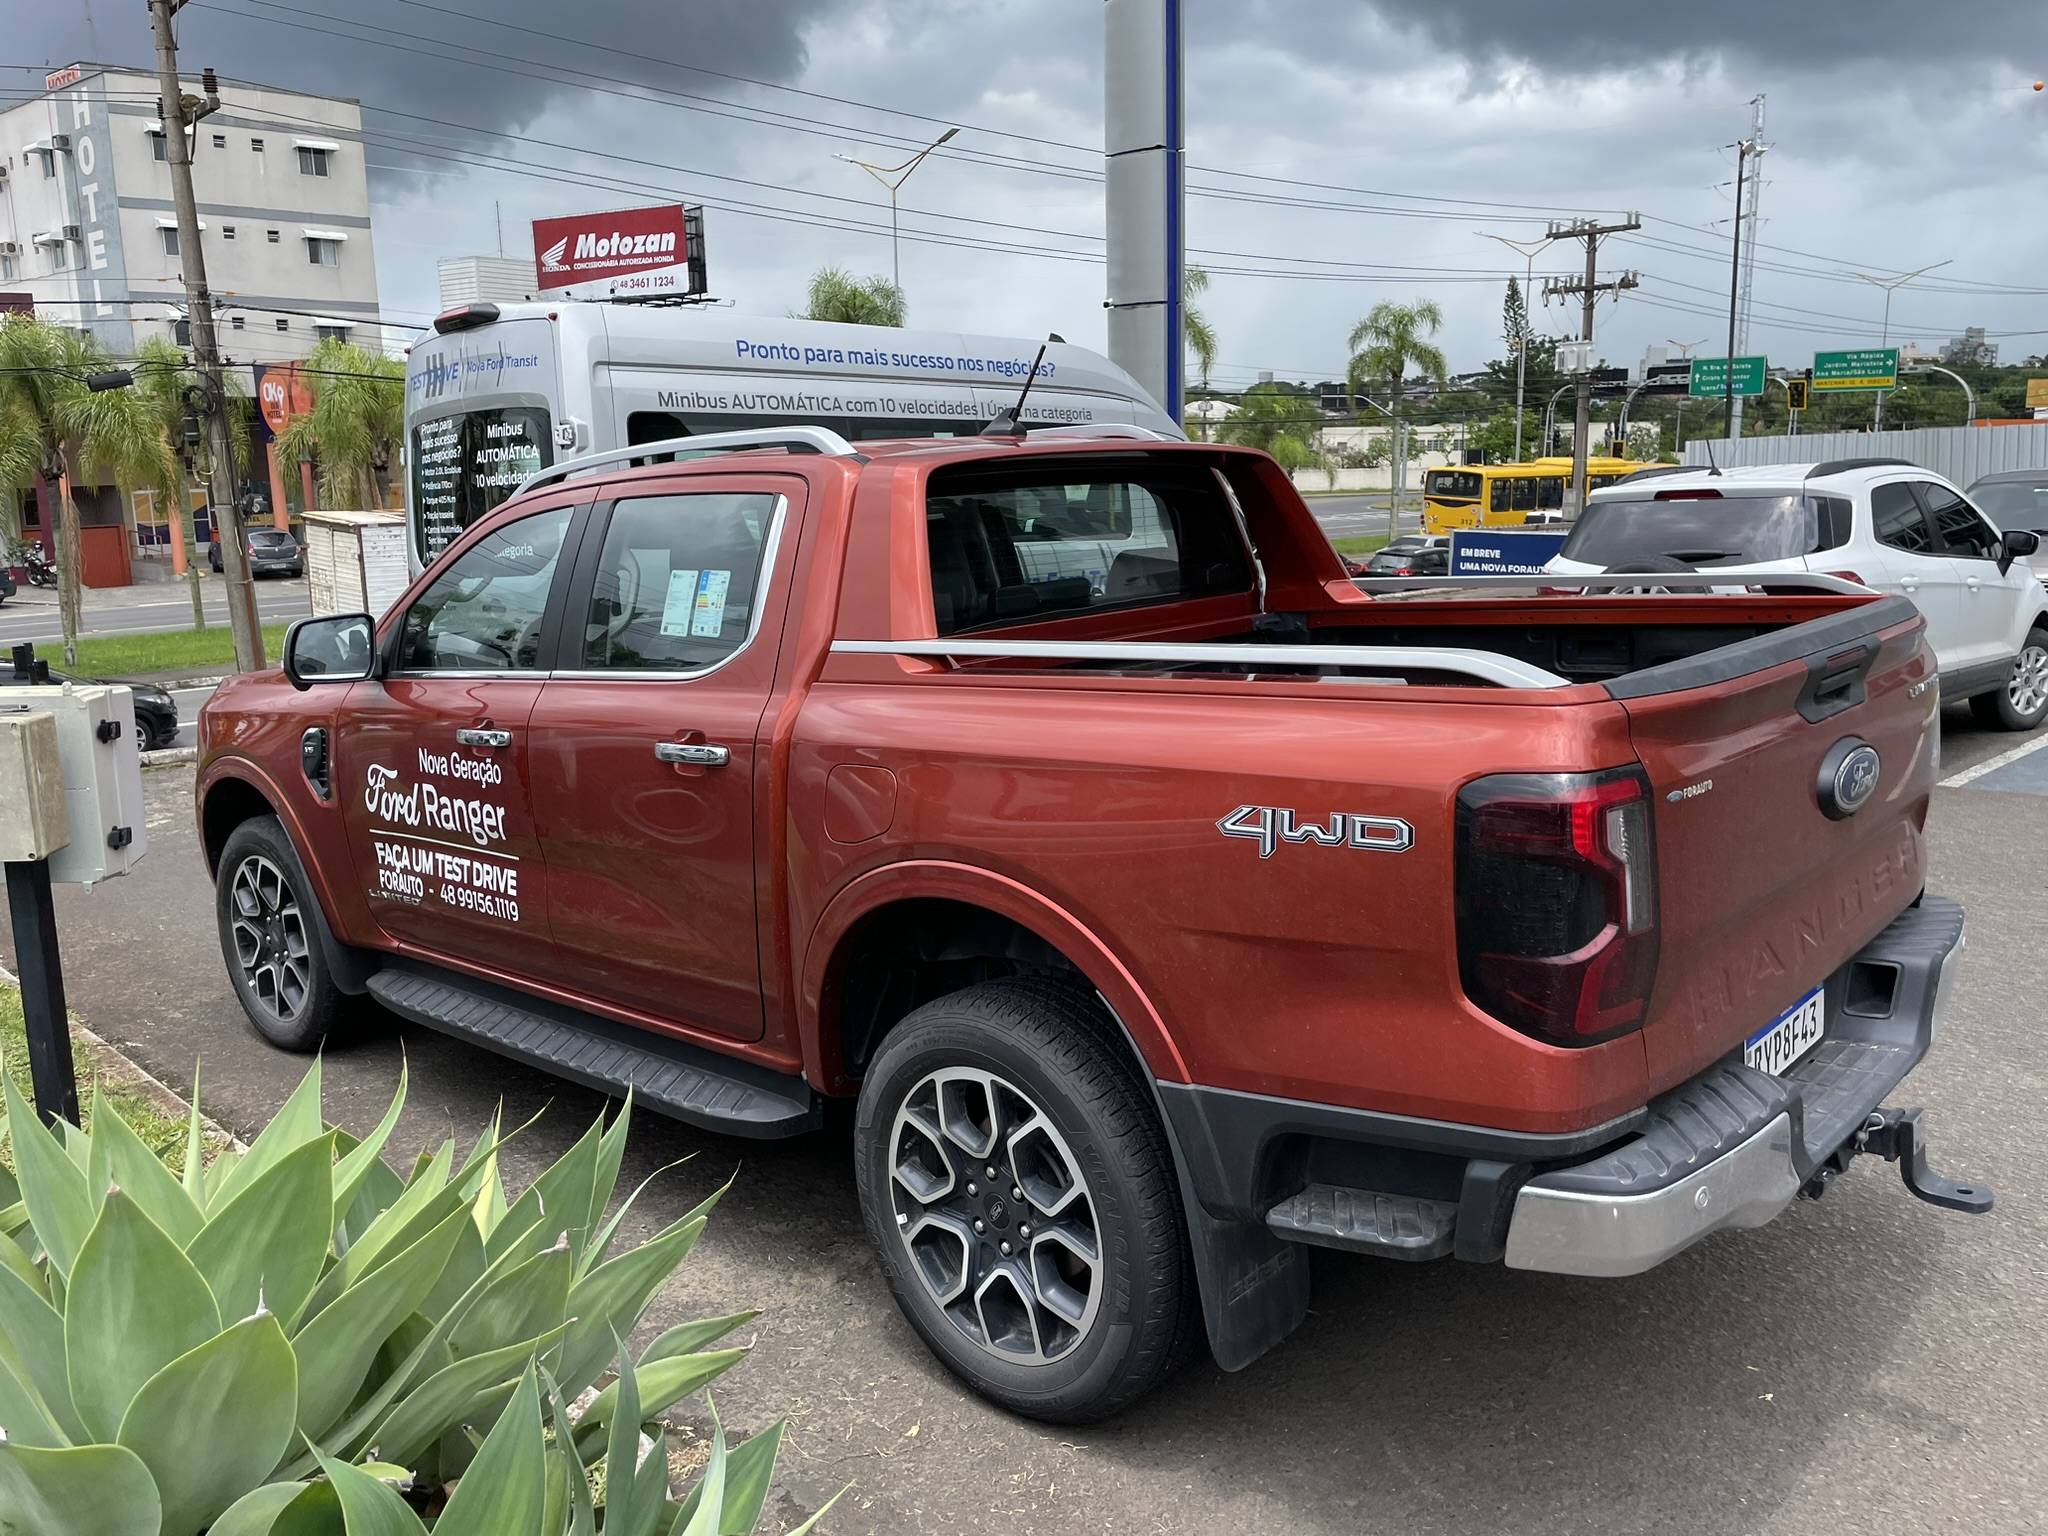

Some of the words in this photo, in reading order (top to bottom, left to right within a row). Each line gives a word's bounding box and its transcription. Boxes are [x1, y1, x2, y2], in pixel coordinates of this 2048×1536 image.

[71, 86, 113, 316] HOTEL
[574, 231, 676, 259] Motozan
[542, 264, 571, 273] HONDA
[573, 259, 618, 270] CONCESSIONÁRIA
[618, 257, 653, 267] AUTORIZADA
[653, 254, 675, 263] HONDA
[619, 280, 628, 289] 48
[629, 277, 650, 289] 3461
[654, 276, 675, 287] 1234
[466, 360, 486, 374] Nova
[486, 358, 504, 370] Ford
[506, 354, 538, 368] Transit
[736, 339, 800, 361] Pronto
[804, 346, 844, 365] para
[848, 348, 888, 367] mais
[891, 351, 953, 370] sucesso
[957, 356, 984, 372] nos
[658, 391, 728, 409] Minibus
[732, 391, 843, 413] AUTOMÁTICA
[846, 400, 877, 413] com
[880, 398, 896, 413] 10
[899, 398, 978, 416] velocidades
[1024, 408, 1040, 419] na
[1041, 407, 1093, 423] categoria
[421, 421, 439, 435] Pronto
[439, 419, 452, 433] para
[487, 422, 523, 438] Minibus
[421, 437, 434, 450] mais
[434, 433, 458, 447] sucesso
[422, 453, 431, 465] nos
[431, 445, 461, 464] negócios?
[476, 443, 540, 464] AUTOMÁTICA
[475, 474, 485, 488] 10
[1460, 518, 1473, 526] 312
[1461, 547, 1474, 558] EM
[1474, 549, 1501, 559] BREVE
[1460, 562, 1480, 571] UMA
[1481, 563, 1507, 572] NOVA
[1507, 564, 1544, 574] FORAUT
[418, 747, 448, 776] Nova
[450, 751, 502, 788] Geração
[1851, 761, 1875, 797] Ford
[1682, 779, 1713, 800] FORAUTO
[365, 763, 422, 826] Ford
[422, 783, 507, 846] Ranger
[1215, 804, 1416, 859] 4WD
[374, 841, 411, 873] FAÇA
[412, 847, 433, 875] UM
[434, 851, 471, 883] TEST
[473, 861, 517, 896] DRIVE
[368, 888, 421, 906] LIMITED
[379, 869, 424, 897] FORAUTO
[440, 883, 456, 905] 48
[458, 887, 519, 922] 99156.1119
